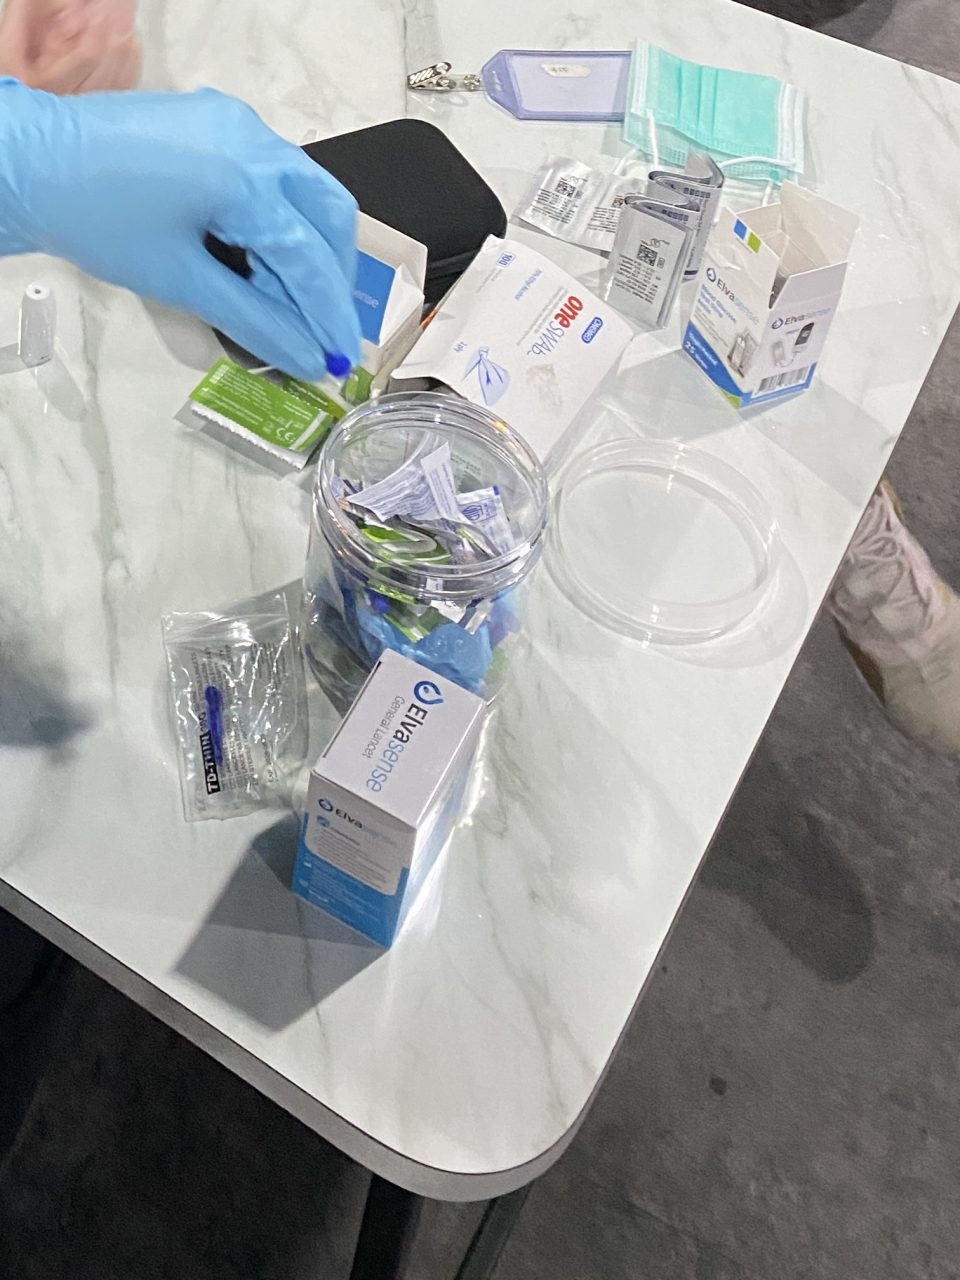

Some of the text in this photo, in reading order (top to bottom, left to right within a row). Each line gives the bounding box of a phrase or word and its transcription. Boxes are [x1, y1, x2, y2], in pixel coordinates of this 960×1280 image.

[500, 253, 513, 266] 100
[361, 696, 406, 759] General Lancet
[366, 703, 429, 792] Elvasense
[201, 734, 218, 792] TD-THIN
